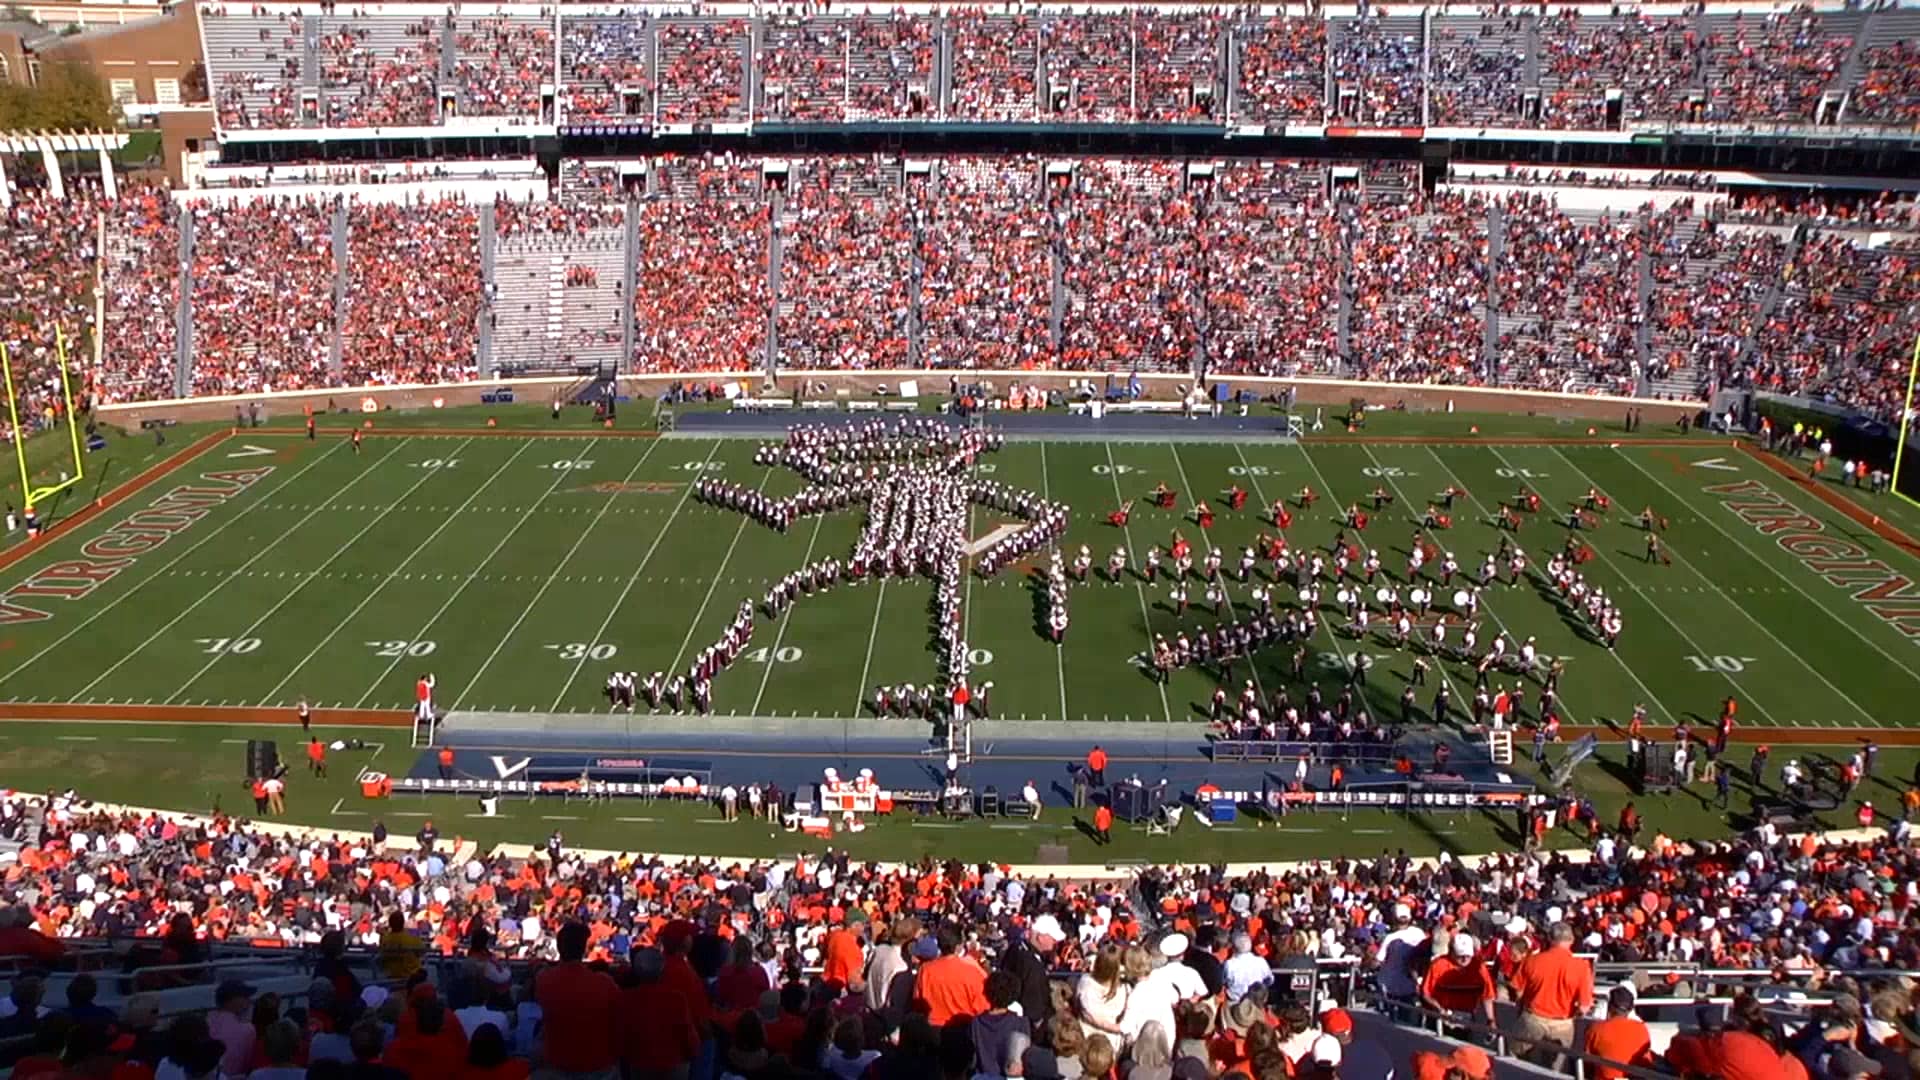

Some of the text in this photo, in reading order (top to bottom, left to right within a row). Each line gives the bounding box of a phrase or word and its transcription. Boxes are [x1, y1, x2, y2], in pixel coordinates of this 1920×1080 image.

[0, 466, 277, 625] VIRGINIA
[1702, 479, 1920, 647] VIRGINI
[202, 637, 263, 654] 10
[375, 640, 437, 656] 20
[559, 643, 618, 661] 30
[744, 646, 803, 663] 40
[967, 649, 994, 665] 0
[1683, 655, 1745, 672] 10
